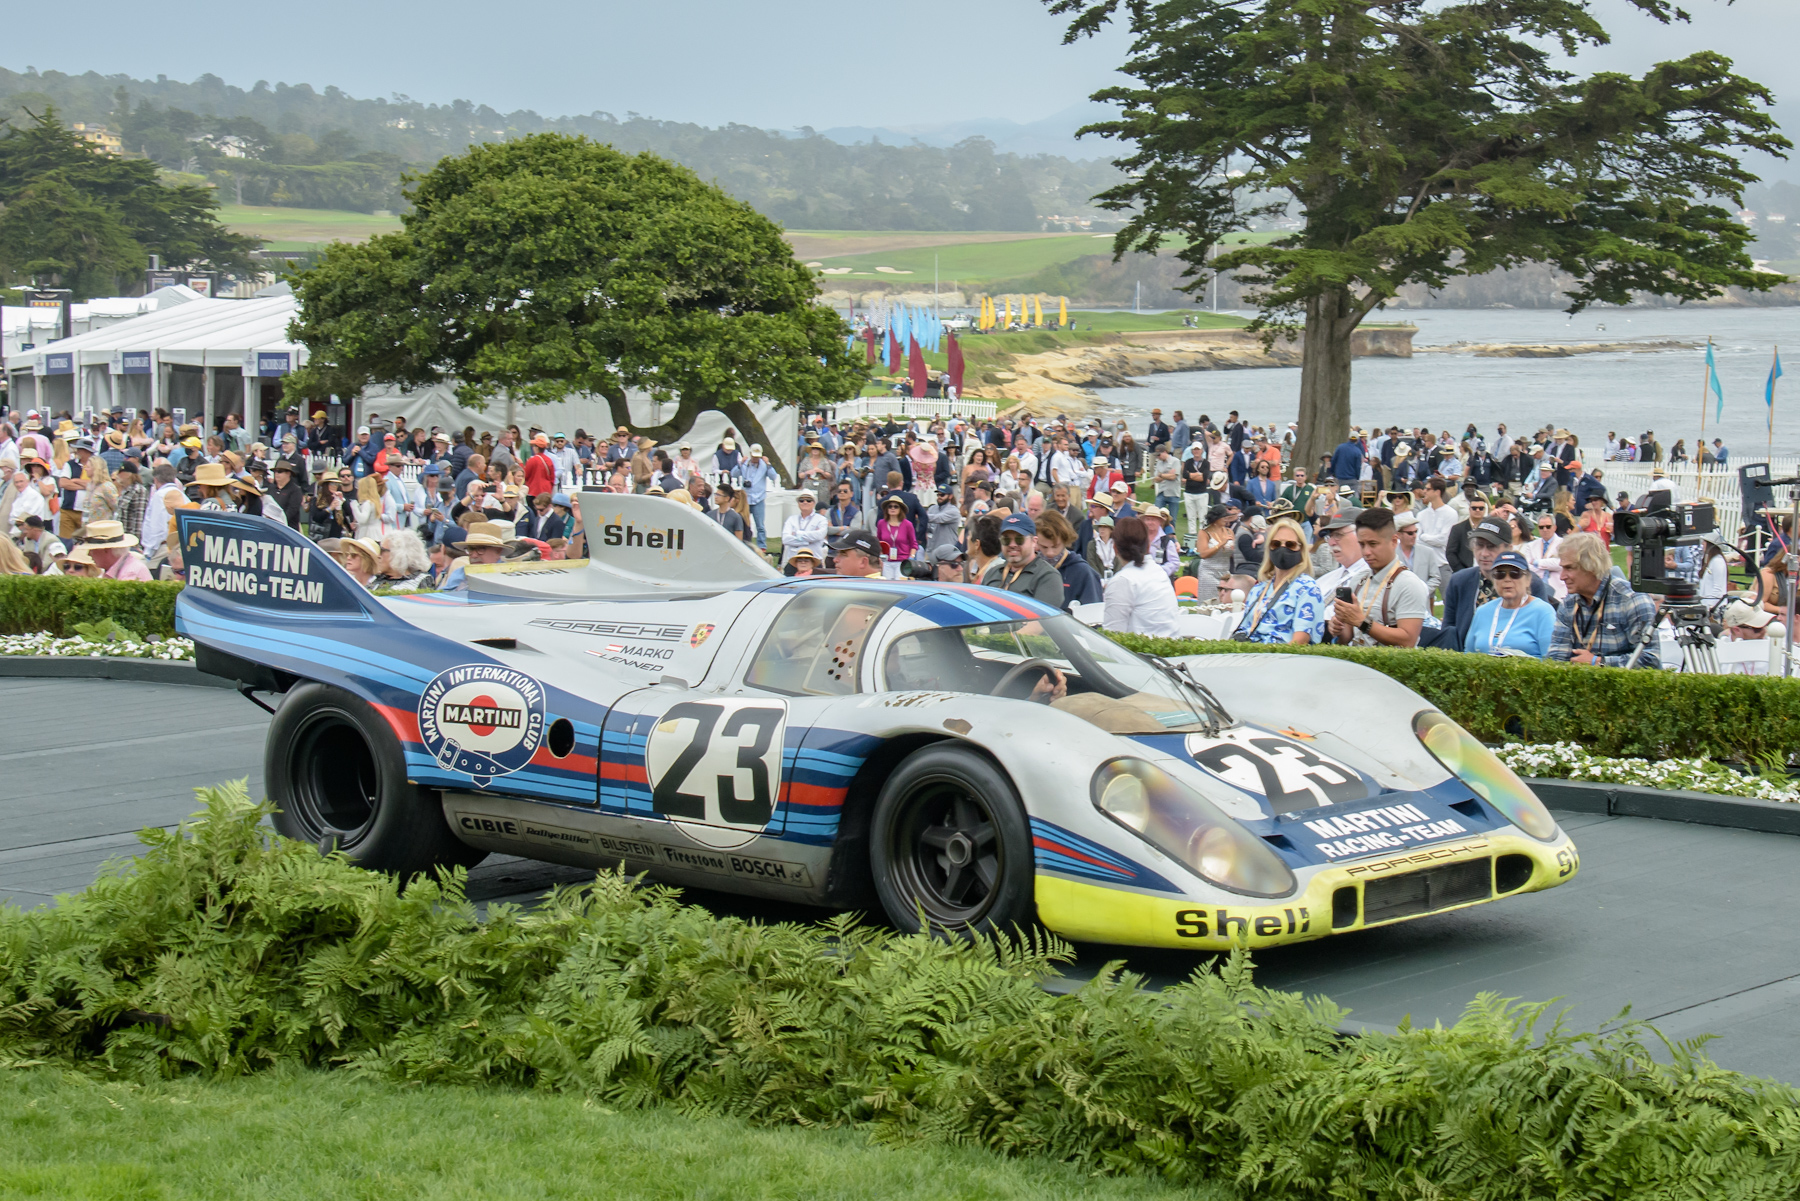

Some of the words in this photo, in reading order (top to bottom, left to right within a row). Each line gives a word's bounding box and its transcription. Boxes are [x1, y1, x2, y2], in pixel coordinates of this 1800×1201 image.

[603, 524, 685, 551] Shell
[203, 534, 311, 576] MARTINI
[188, 564, 324, 604] RACING-TEAM
[527, 619, 686, 639] PORSCHE
[619, 645, 674, 660] MARKO
[422, 680, 446, 744] MARTINI
[449, 666, 541, 709] INTERNATIONAL
[522, 712, 542, 751] CLUB
[445, 705, 519, 727] MARTINI
[652, 701, 785, 826] 23
[1193, 737, 1369, 816] 23
[1303, 803, 1431, 839] MARTINI
[600, 837, 655, 856] BILSTEIN
[1315, 818, 1467, 859] RACING-TEAM
[663, 847, 725, 869] Firestone
[731, 857, 787, 879] BOSCH
[1175, 906, 1311, 938] Shell
